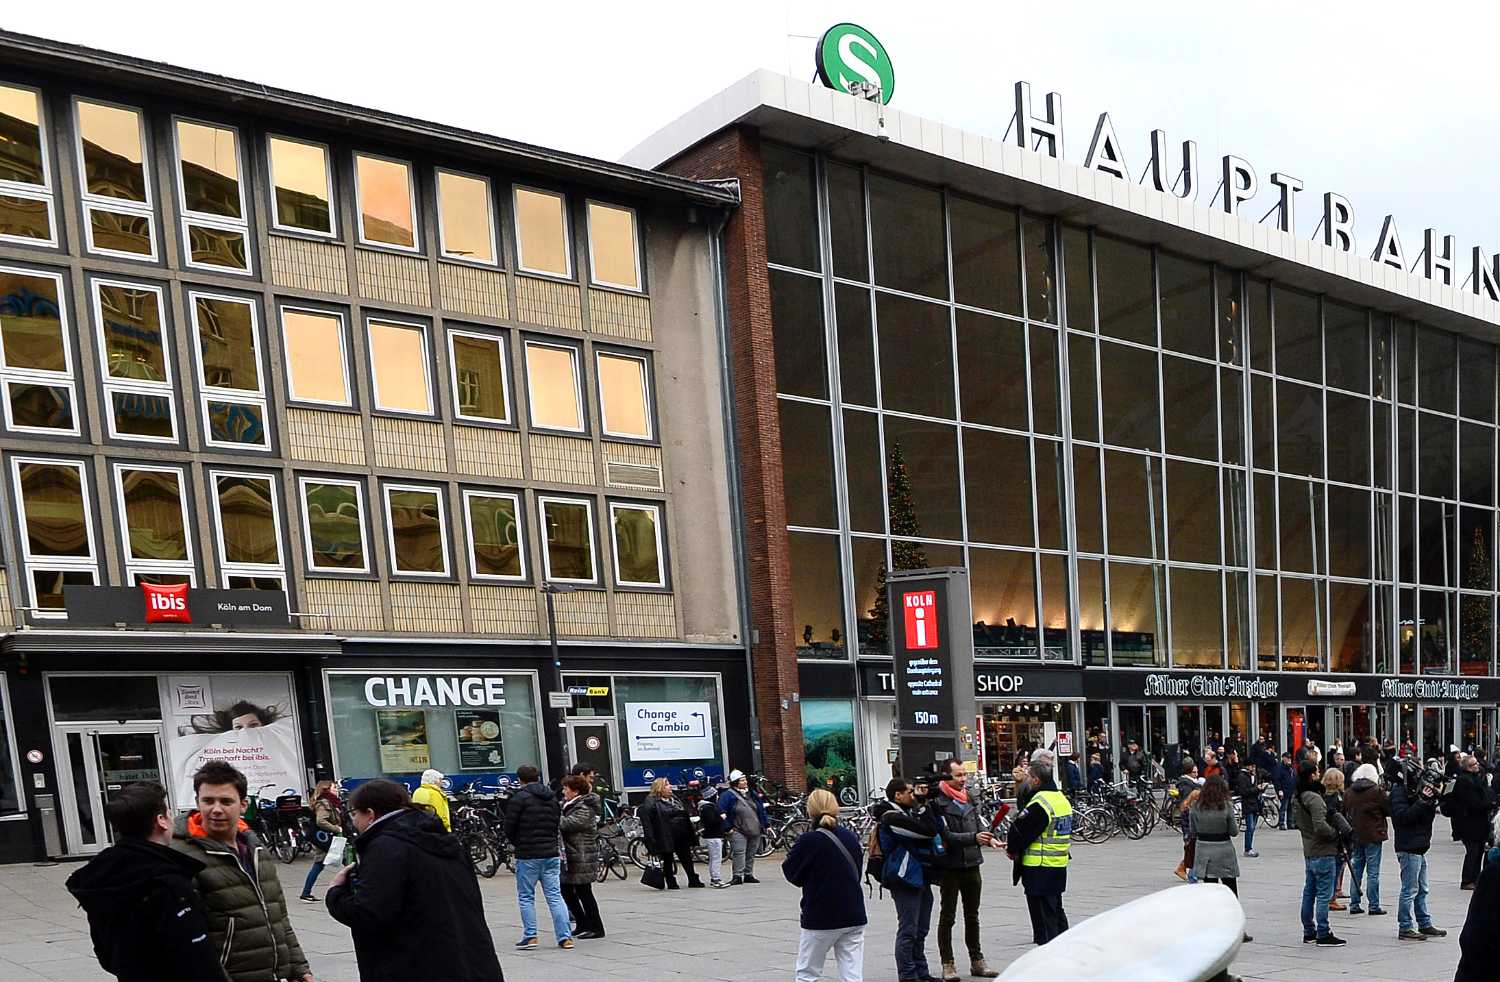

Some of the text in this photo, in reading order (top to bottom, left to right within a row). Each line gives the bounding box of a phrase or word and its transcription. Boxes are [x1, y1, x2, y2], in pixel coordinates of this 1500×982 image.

[838, 33, 882, 97] S
[151, 593, 186, 610] ibis
[217, 602, 237, 611] Köln
[252, 603, 273, 612] Dom
[977, 675, 1023, 692] SHOP
[1144, 674, 1189, 697] Kölner
[365, 677, 506, 707] CHANGE
[637, 709, 677, 721] Change
[914, 711, 938, 724] 150 m
[651, 722, 690, 732] Cambio
[236, 746, 263, 754] Nacht?
